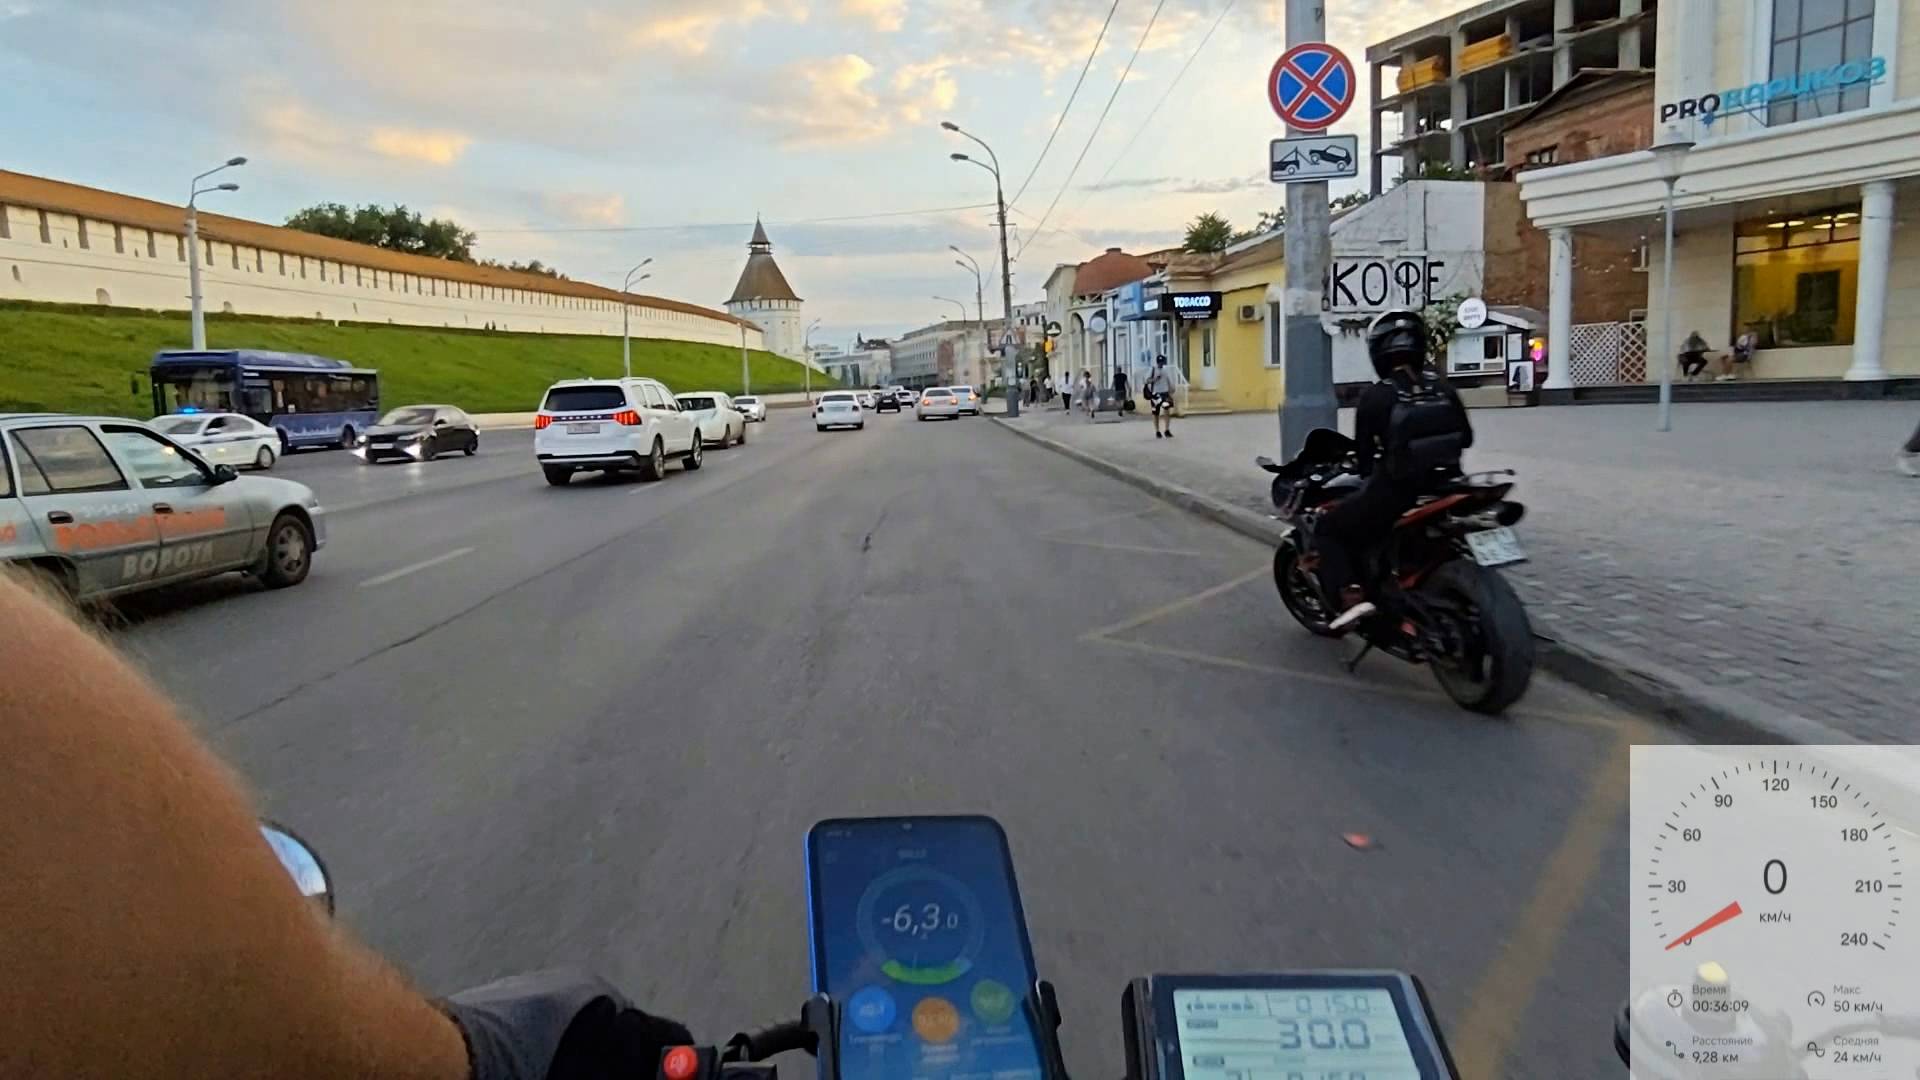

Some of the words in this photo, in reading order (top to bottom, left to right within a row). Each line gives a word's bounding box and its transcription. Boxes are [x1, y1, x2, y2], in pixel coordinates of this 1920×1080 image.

[1332, 260, 1445, 306] КОФЕ
[1173, 296, 1211, 308] TOBACCO
[122, 540, 214, 579] ВОРОТА
[881, 902, 940, 936] -6,3
